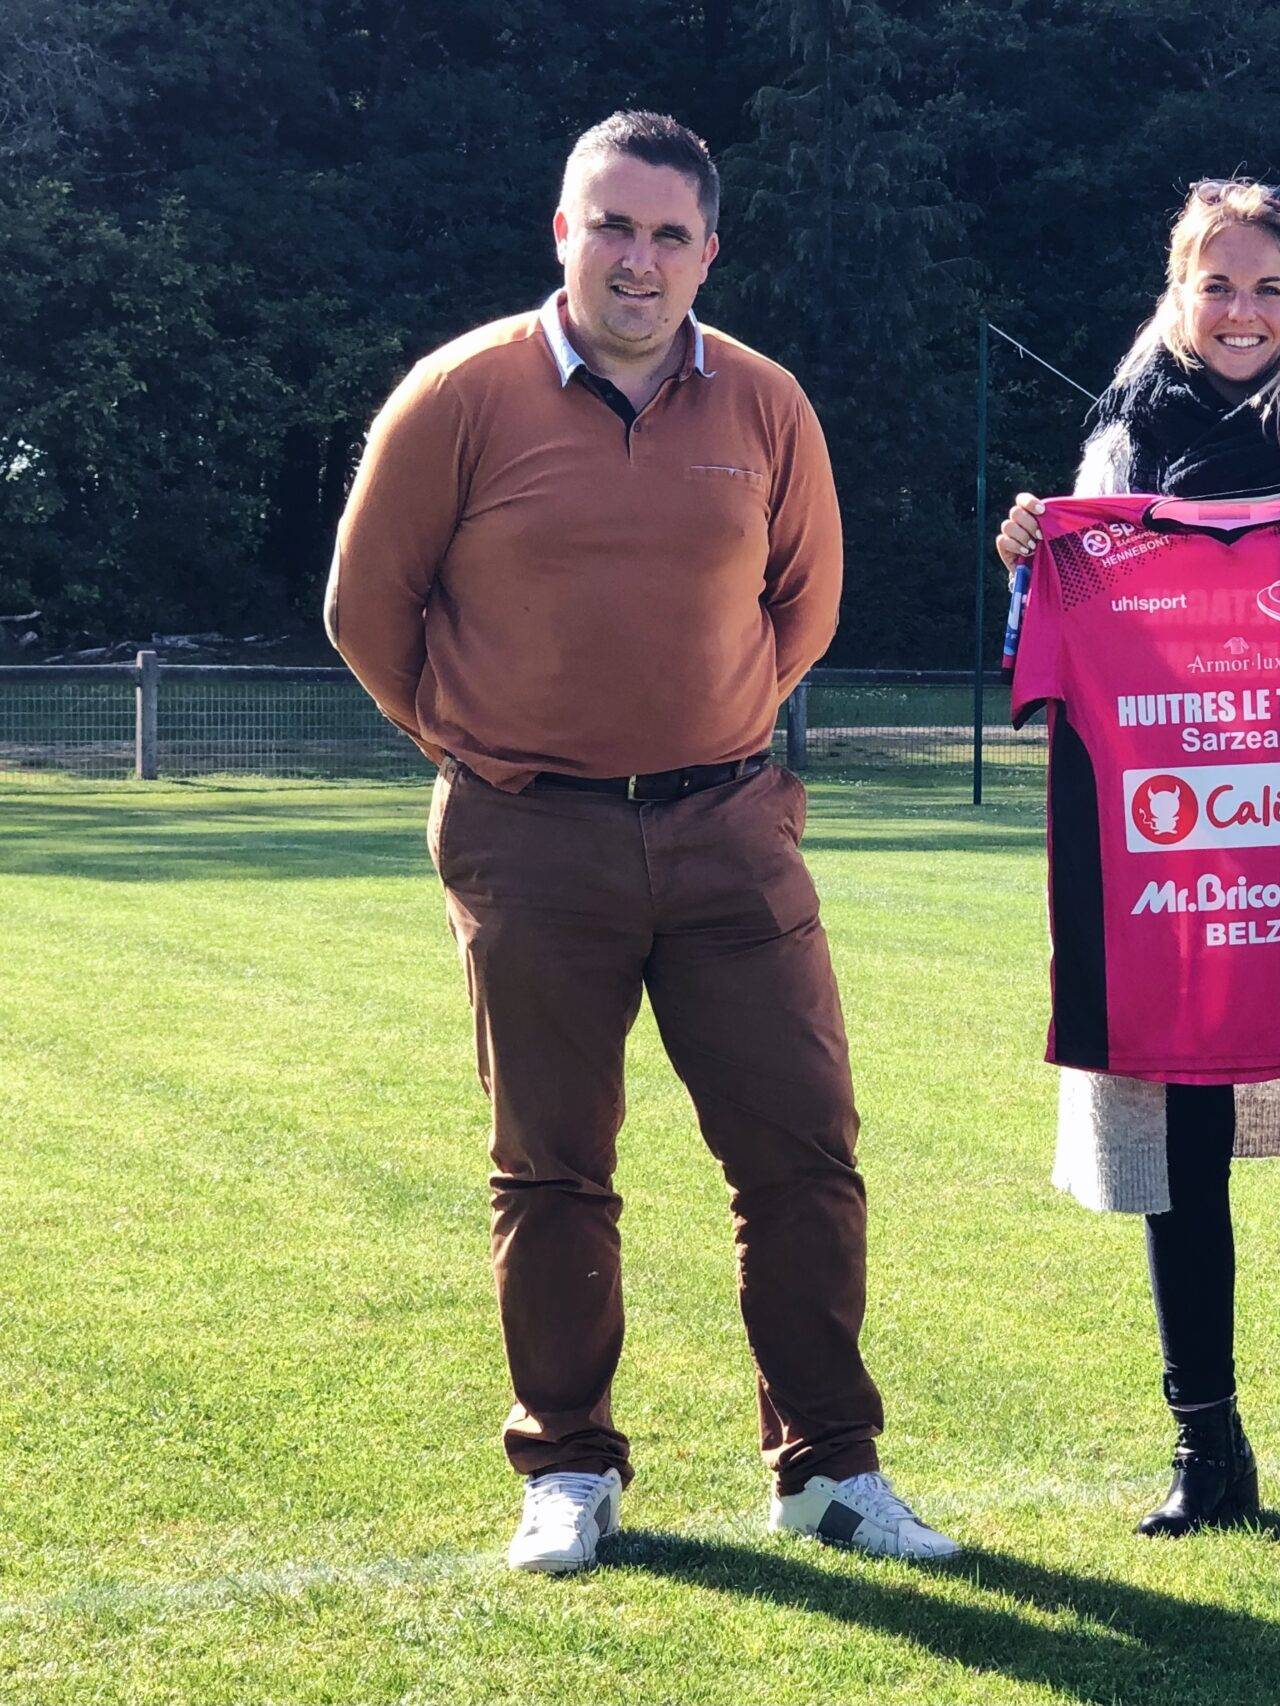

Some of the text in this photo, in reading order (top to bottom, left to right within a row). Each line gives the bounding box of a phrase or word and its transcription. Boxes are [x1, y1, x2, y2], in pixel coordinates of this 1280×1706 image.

[1102, 534, 1170, 568] HENNEBONT
[1111, 593, 1188, 613] uhlsport
[1117, 690, 1237, 727] HUITRES
[1243, 688, 1271, 721] LE
